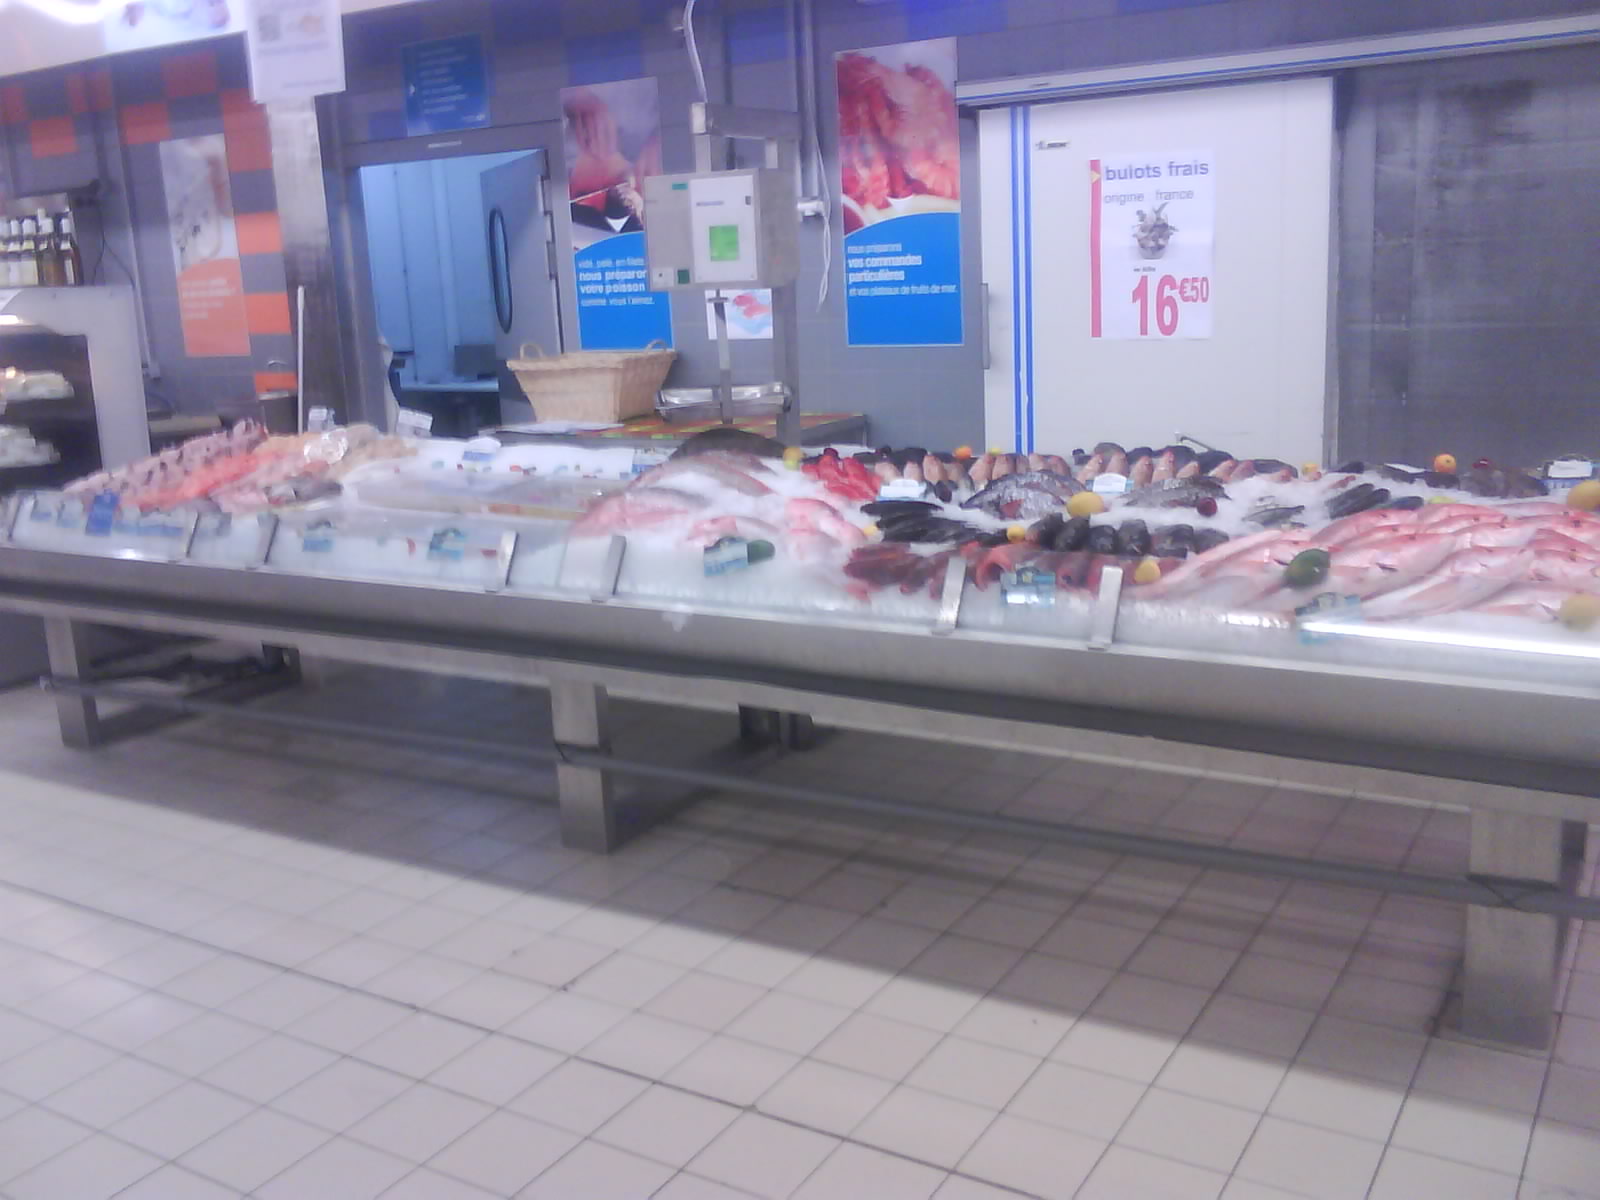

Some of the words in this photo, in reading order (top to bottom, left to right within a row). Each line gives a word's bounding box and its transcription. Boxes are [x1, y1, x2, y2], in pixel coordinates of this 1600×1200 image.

[1105, 163, 1162, 181] bulots
[1168, 160, 1210, 178] frais
[1104, 191, 1144, 206] origine
[1155, 188, 1194, 201] france
[579, 271, 602, 281] nous
[605, 283, 646, 296] poisson
